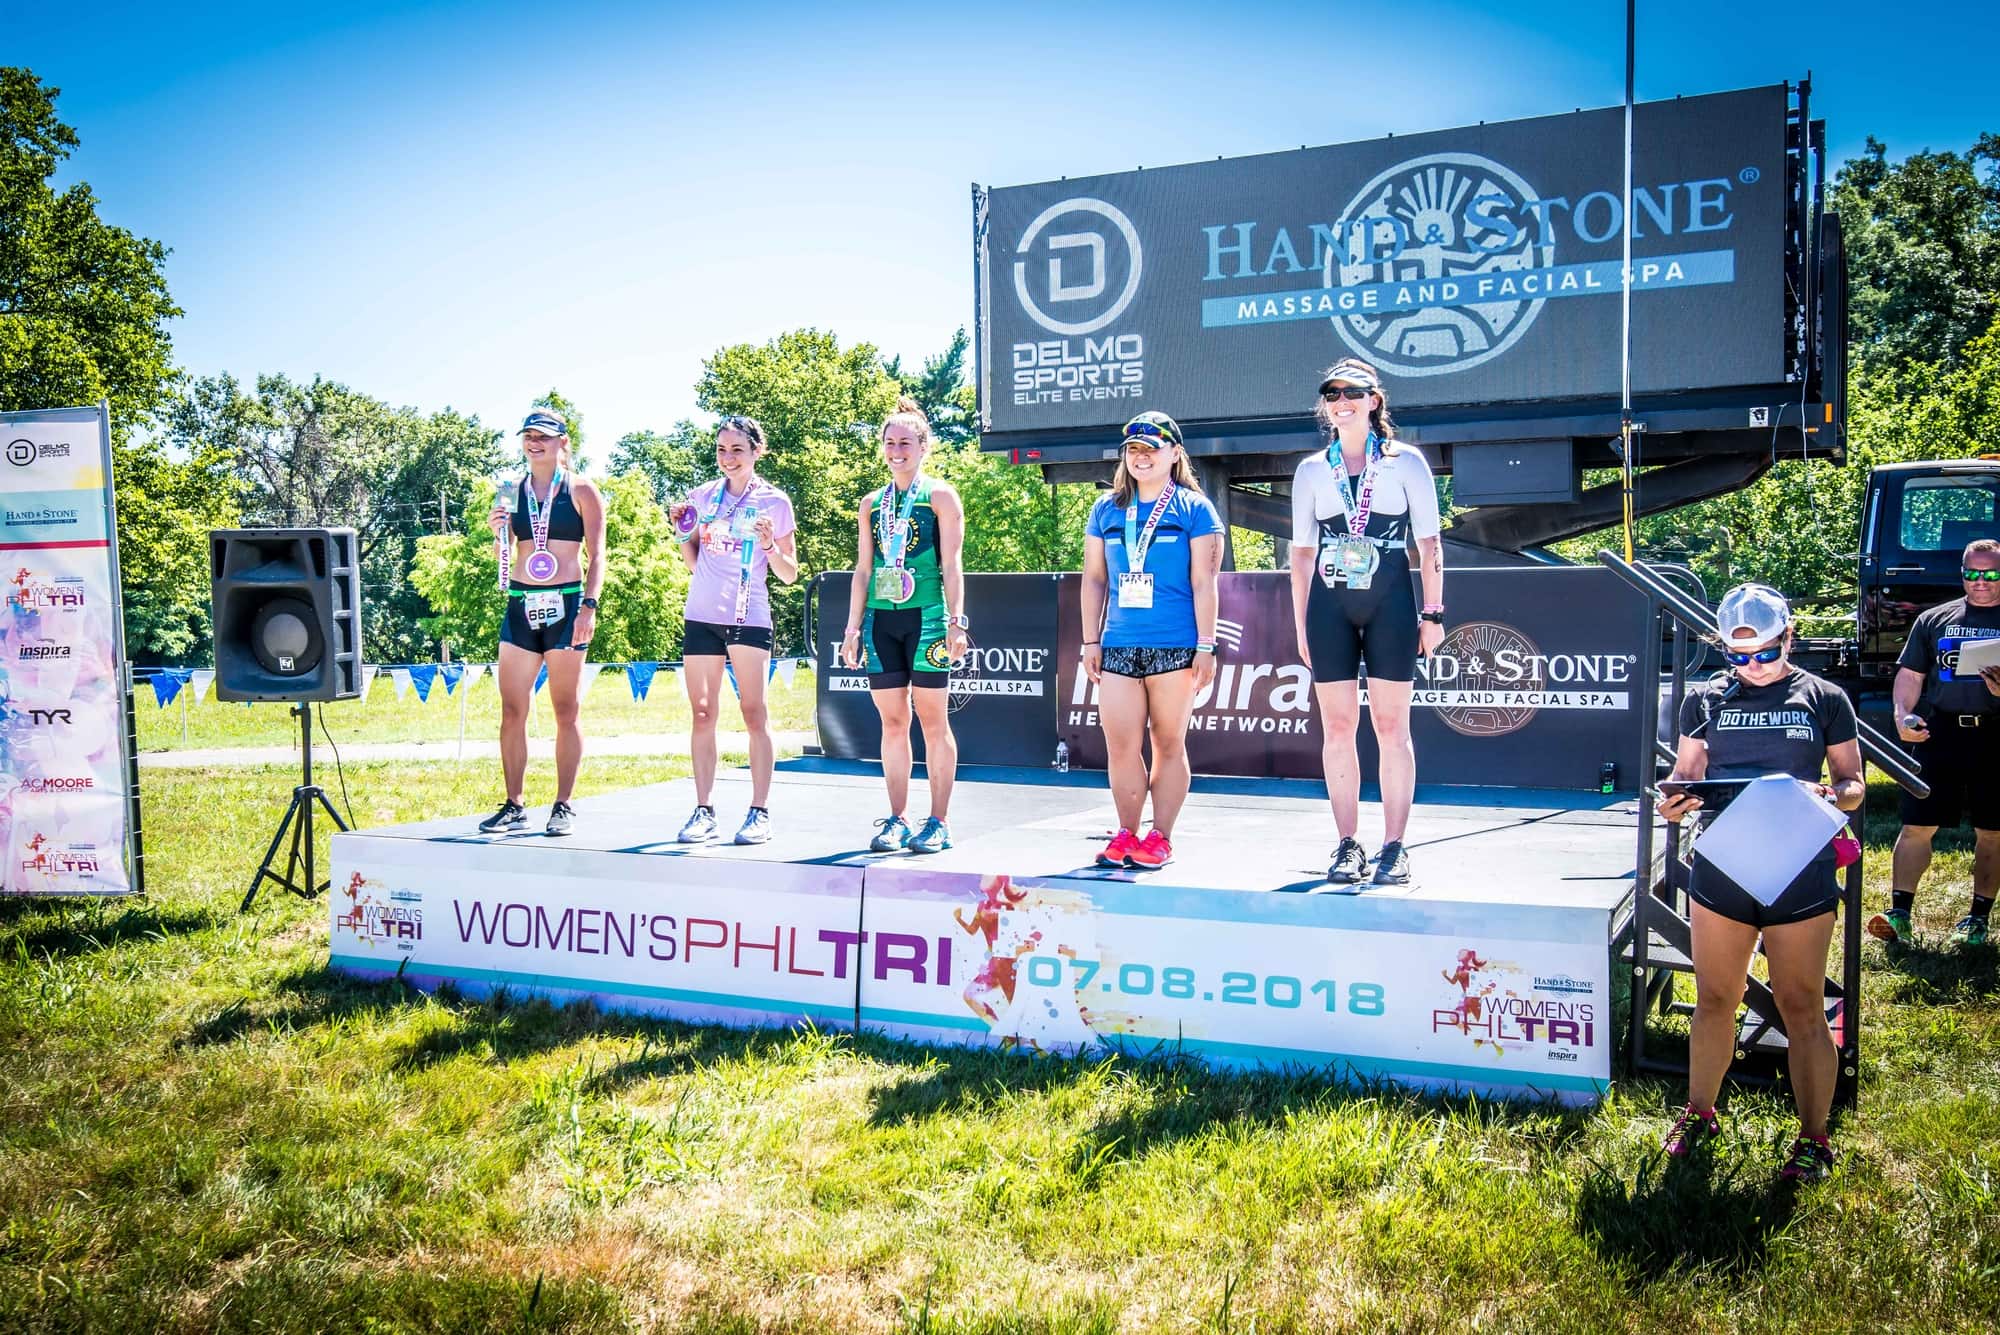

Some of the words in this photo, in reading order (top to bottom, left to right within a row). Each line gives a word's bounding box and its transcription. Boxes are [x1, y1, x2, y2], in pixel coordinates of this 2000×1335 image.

[1202, 221, 1408, 281] HAND
[1423, 223, 1445, 245] &
[1237, 289, 1378, 319] MASSAGE
[1396, 283, 1460, 305] AND
[1478, 269, 1601, 297] FACIAL
[1013, 334, 1144, 369] DELMO
[1013, 361, 1144, 391] SPORTS
[1014, 389, 1064, 406] ELITE
[1070, 384, 1144, 402] EVENTS
[7, 511, 34, 520] HAND
[43, 509, 77, 518] STONE
[32, 586, 84, 596] WOMEN'S
[529, 607, 558, 621] 662
[20, 644, 70, 659] inspira
[1467, 656, 1487, 675] &
[950, 682, 1001, 693] FACIAL
[1007, 682, 1034, 694] SPA
[1071, 646, 1312, 713] iira
[1457, 693, 1496, 705] AND
[1503, 693, 1572, 706] FACIAL
[1579, 693, 1616, 707] SPA
[29, 709, 72, 725] TYR
[1189, 716, 1311, 735] NETWORK
[365, 905, 423, 922] WOMEN'S
[1028, 955, 1385, 1016] 07.08.2018
[1534, 977, 1559, 986] HAND
[1484, 996, 1594, 1022] WOMEN'S
[1433, 1010, 1594, 1047] PHLTRI
[1548, 1050, 1577, 1061] inspira
